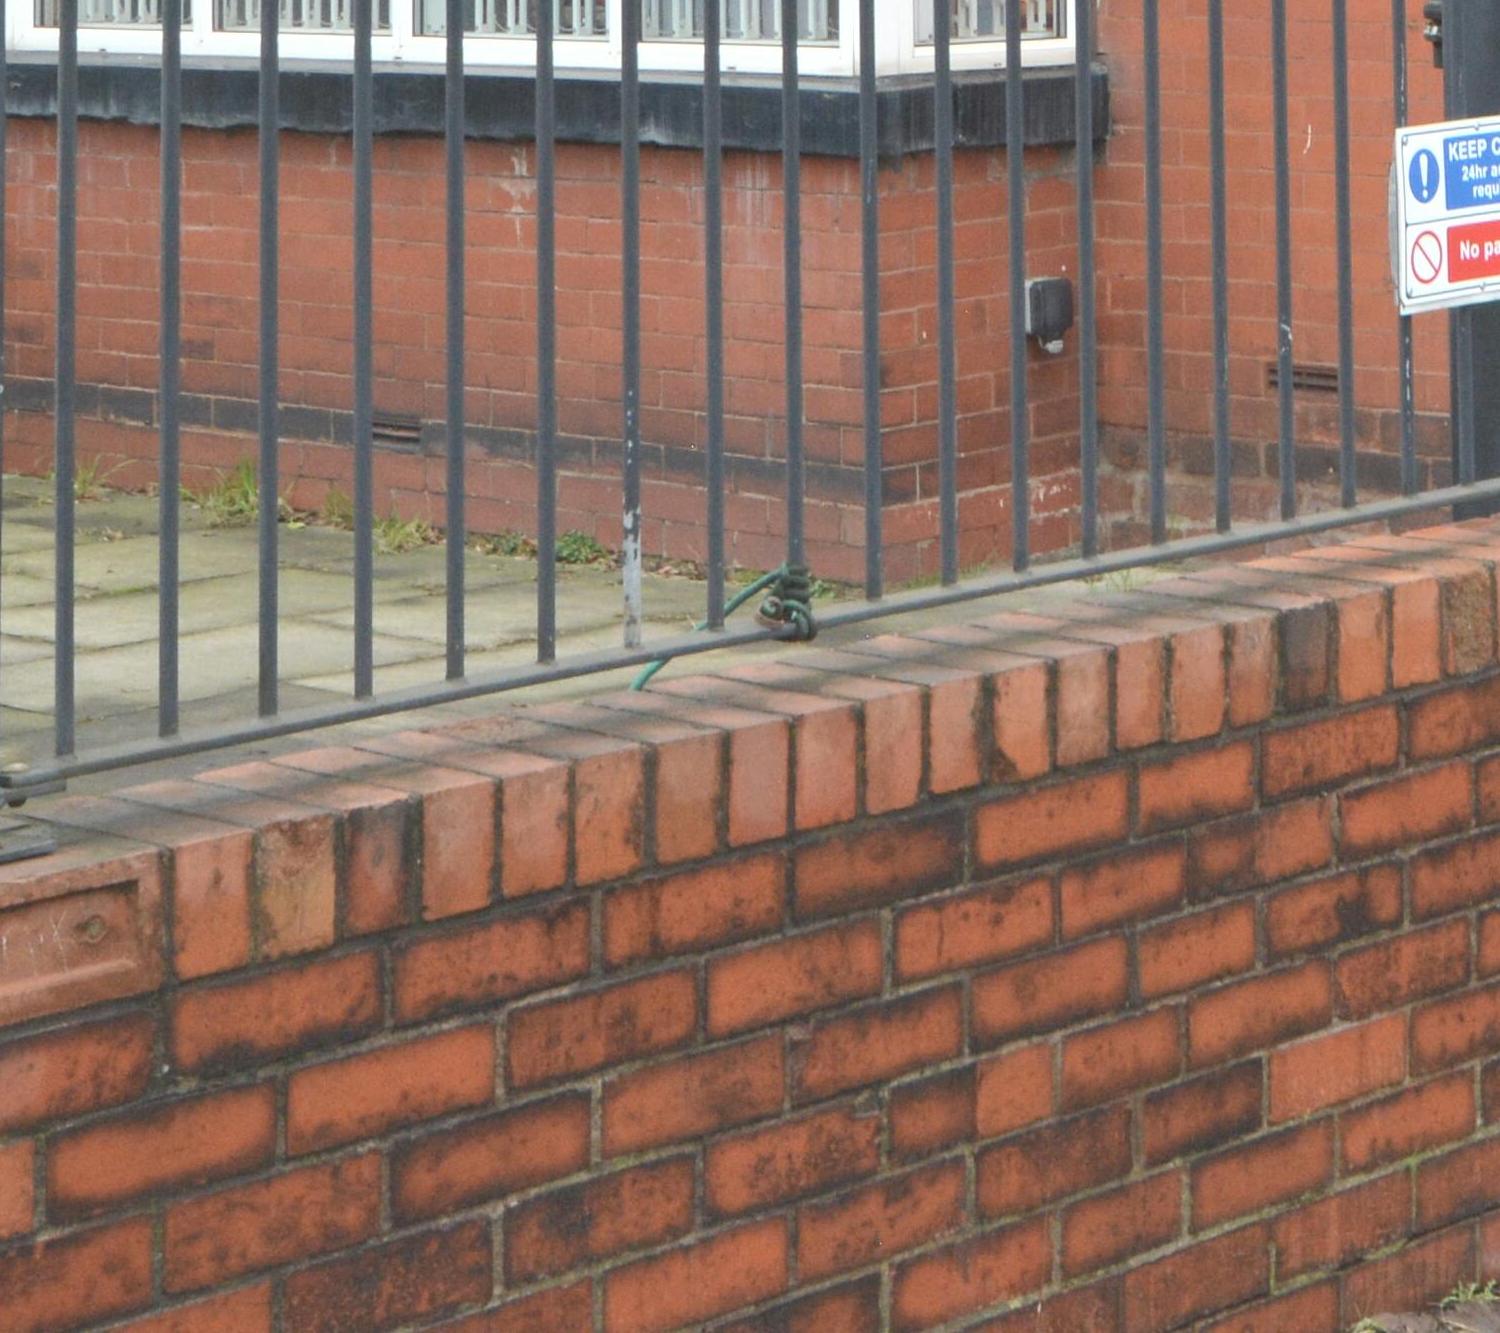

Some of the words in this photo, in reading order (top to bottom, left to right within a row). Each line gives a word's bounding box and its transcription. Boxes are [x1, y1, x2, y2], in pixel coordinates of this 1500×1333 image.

[1448, 138, 1487, 162] KEEP
[1461, 163, 1488, 182] 24hr
[1459, 240, 1480, 261] No
